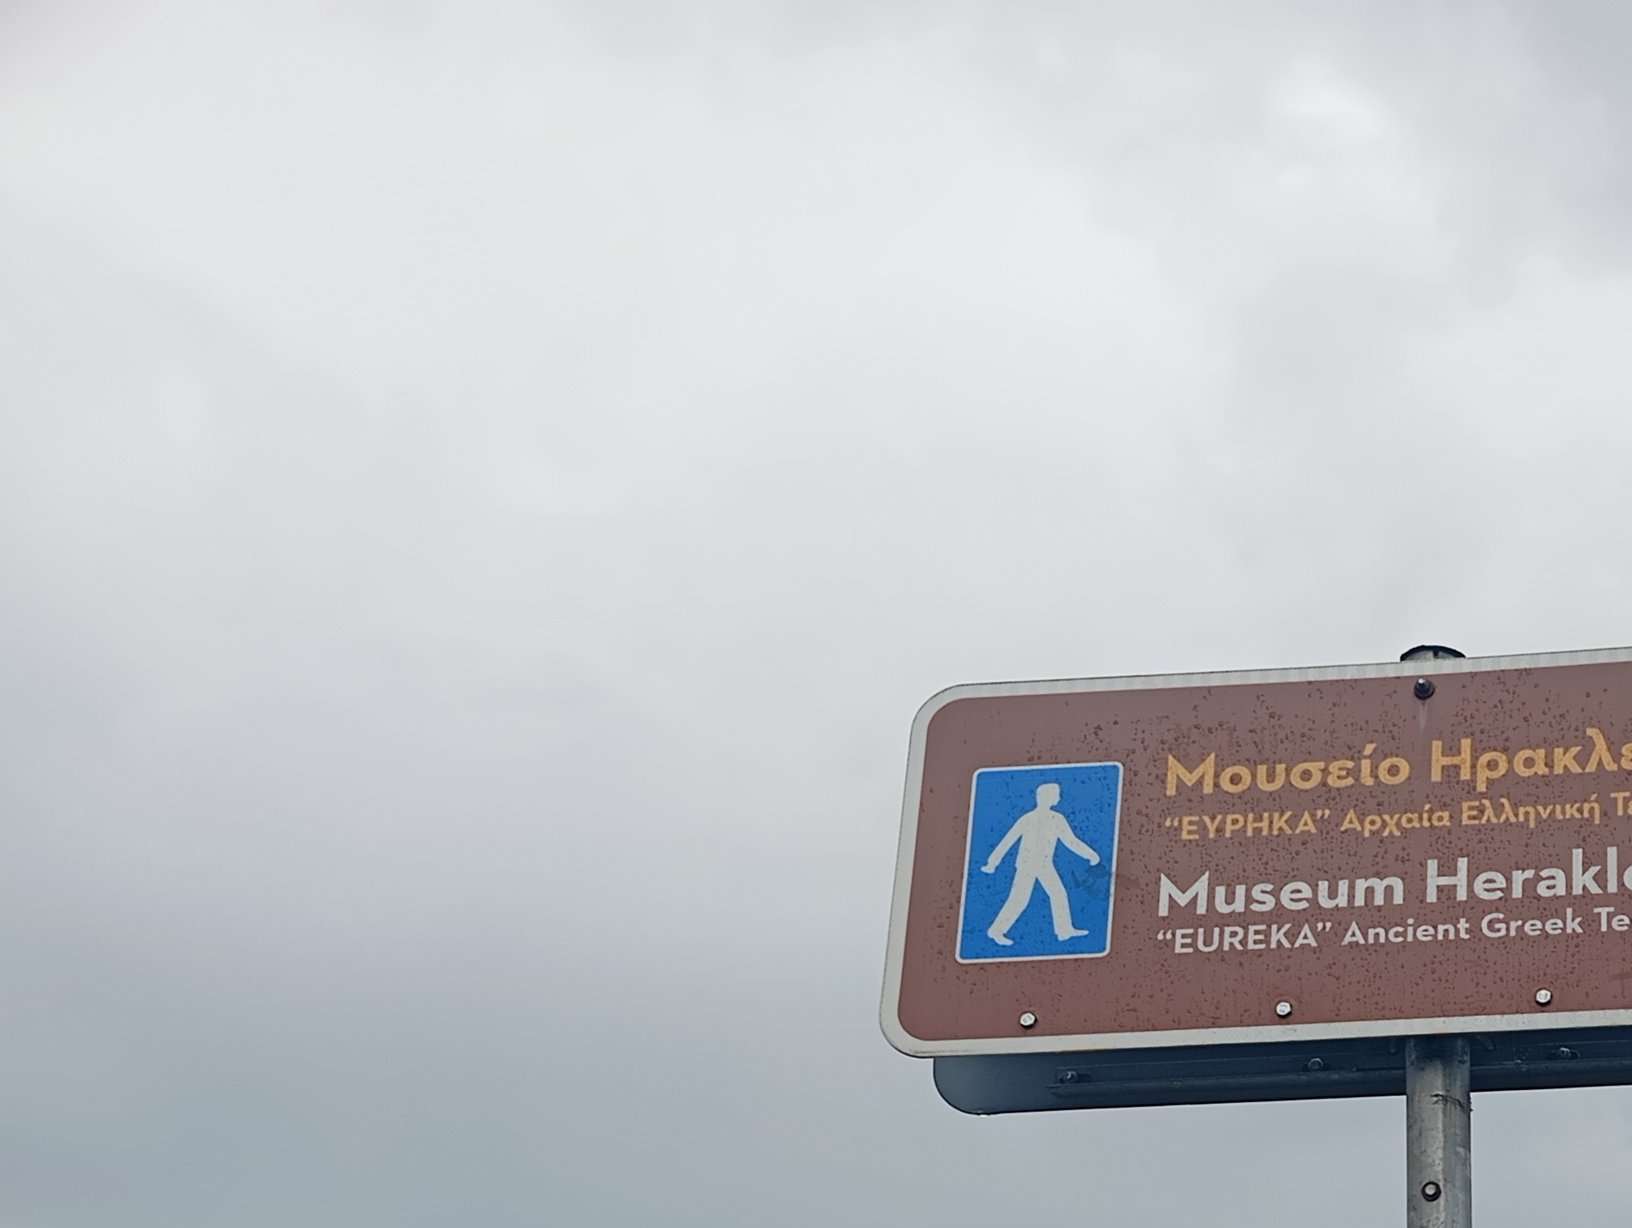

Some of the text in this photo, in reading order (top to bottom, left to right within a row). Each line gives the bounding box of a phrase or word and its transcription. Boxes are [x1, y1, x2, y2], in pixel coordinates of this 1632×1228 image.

[1166, 743, 1411, 797] Μουσείο
[1340, 803, 1452, 838] Αρχαία
[1461, 794, 1601, 828] Ελληνική
[1158, 870, 1405, 918] Museum
[1341, 917, 1471, 946] Ancient
[1481, 908, 1585, 939] Greek
